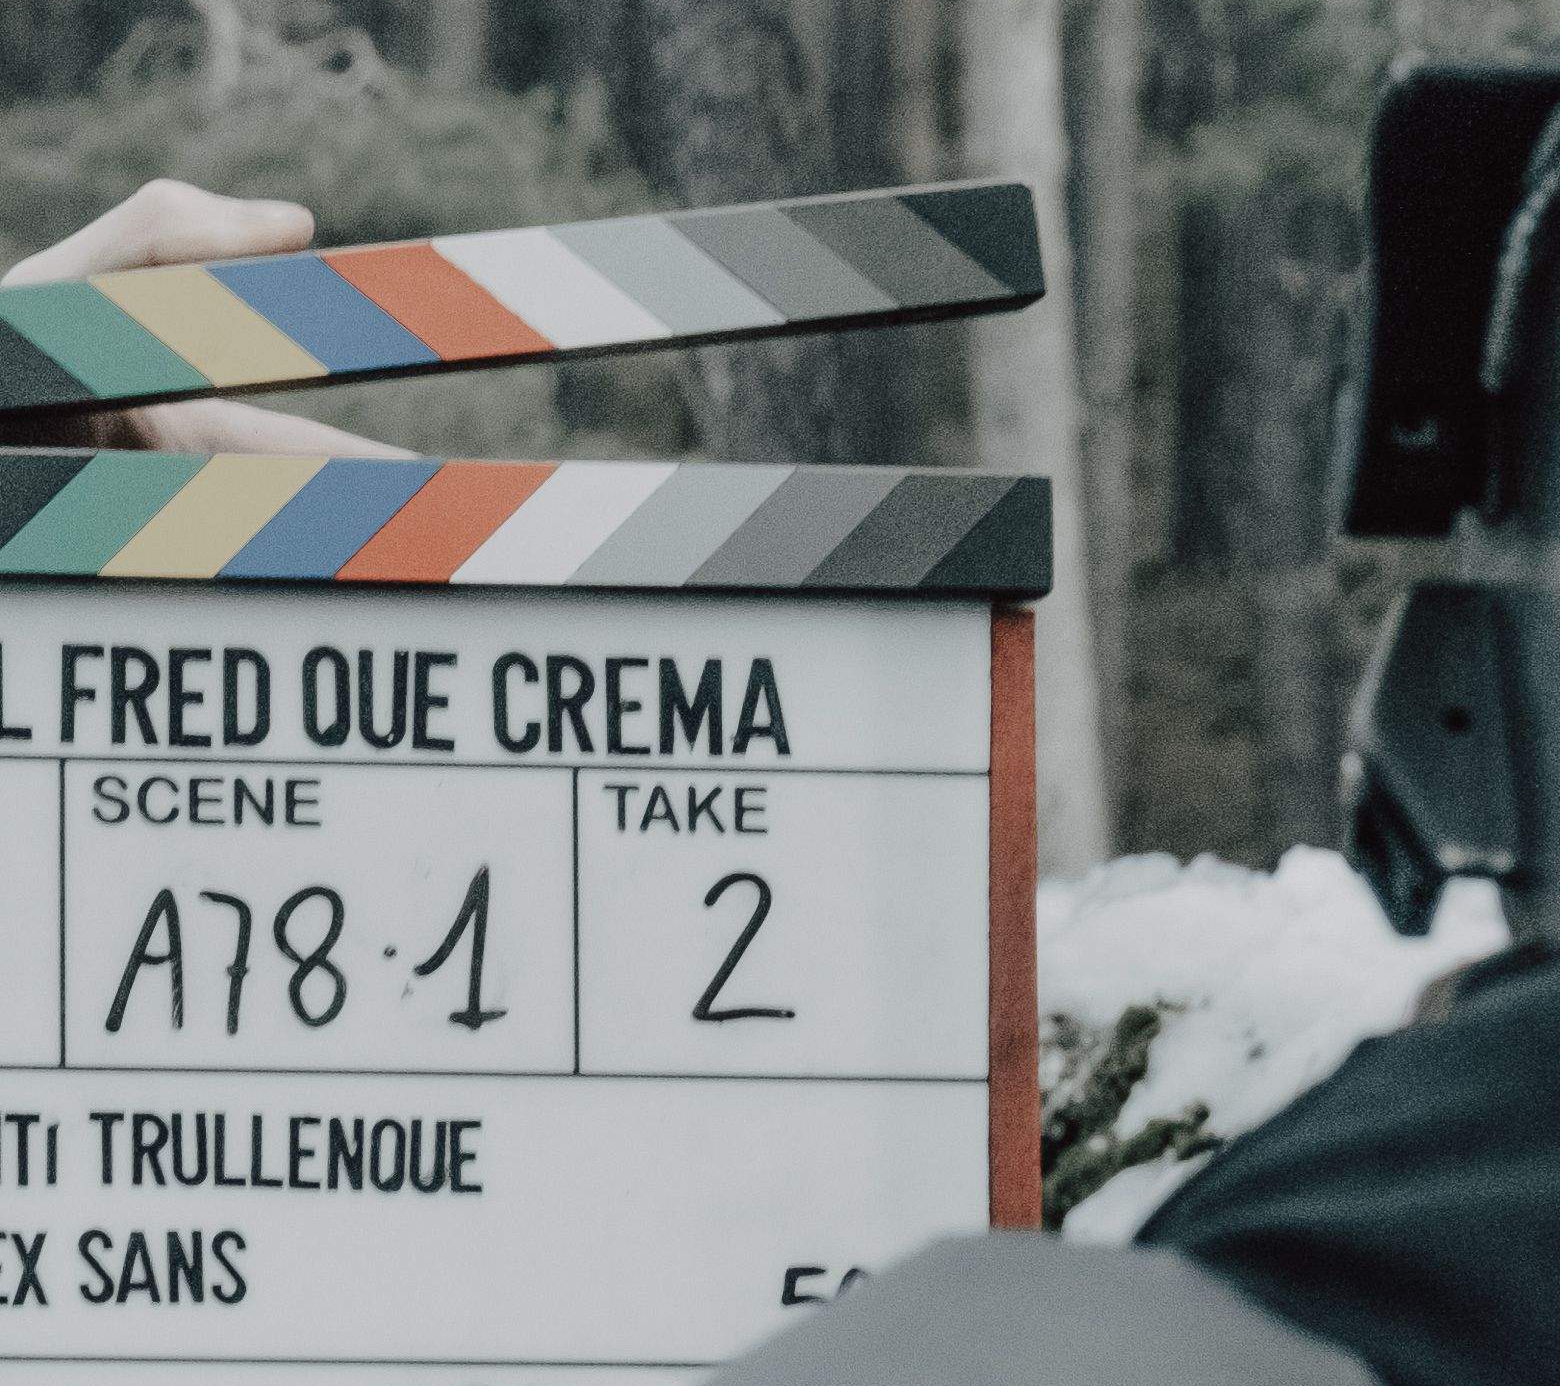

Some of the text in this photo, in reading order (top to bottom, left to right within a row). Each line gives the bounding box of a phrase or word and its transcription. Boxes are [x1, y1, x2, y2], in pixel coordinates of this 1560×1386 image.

[60, 643, 272, 748] FRED
[491, 650, 792, 757] CREMA
[90, 774, 322, 827] SCENE
[602, 783, 769, 834] TAKE
[692, 871, 797, 1024] 2
[78, 1228, 248, 1305] SANS
